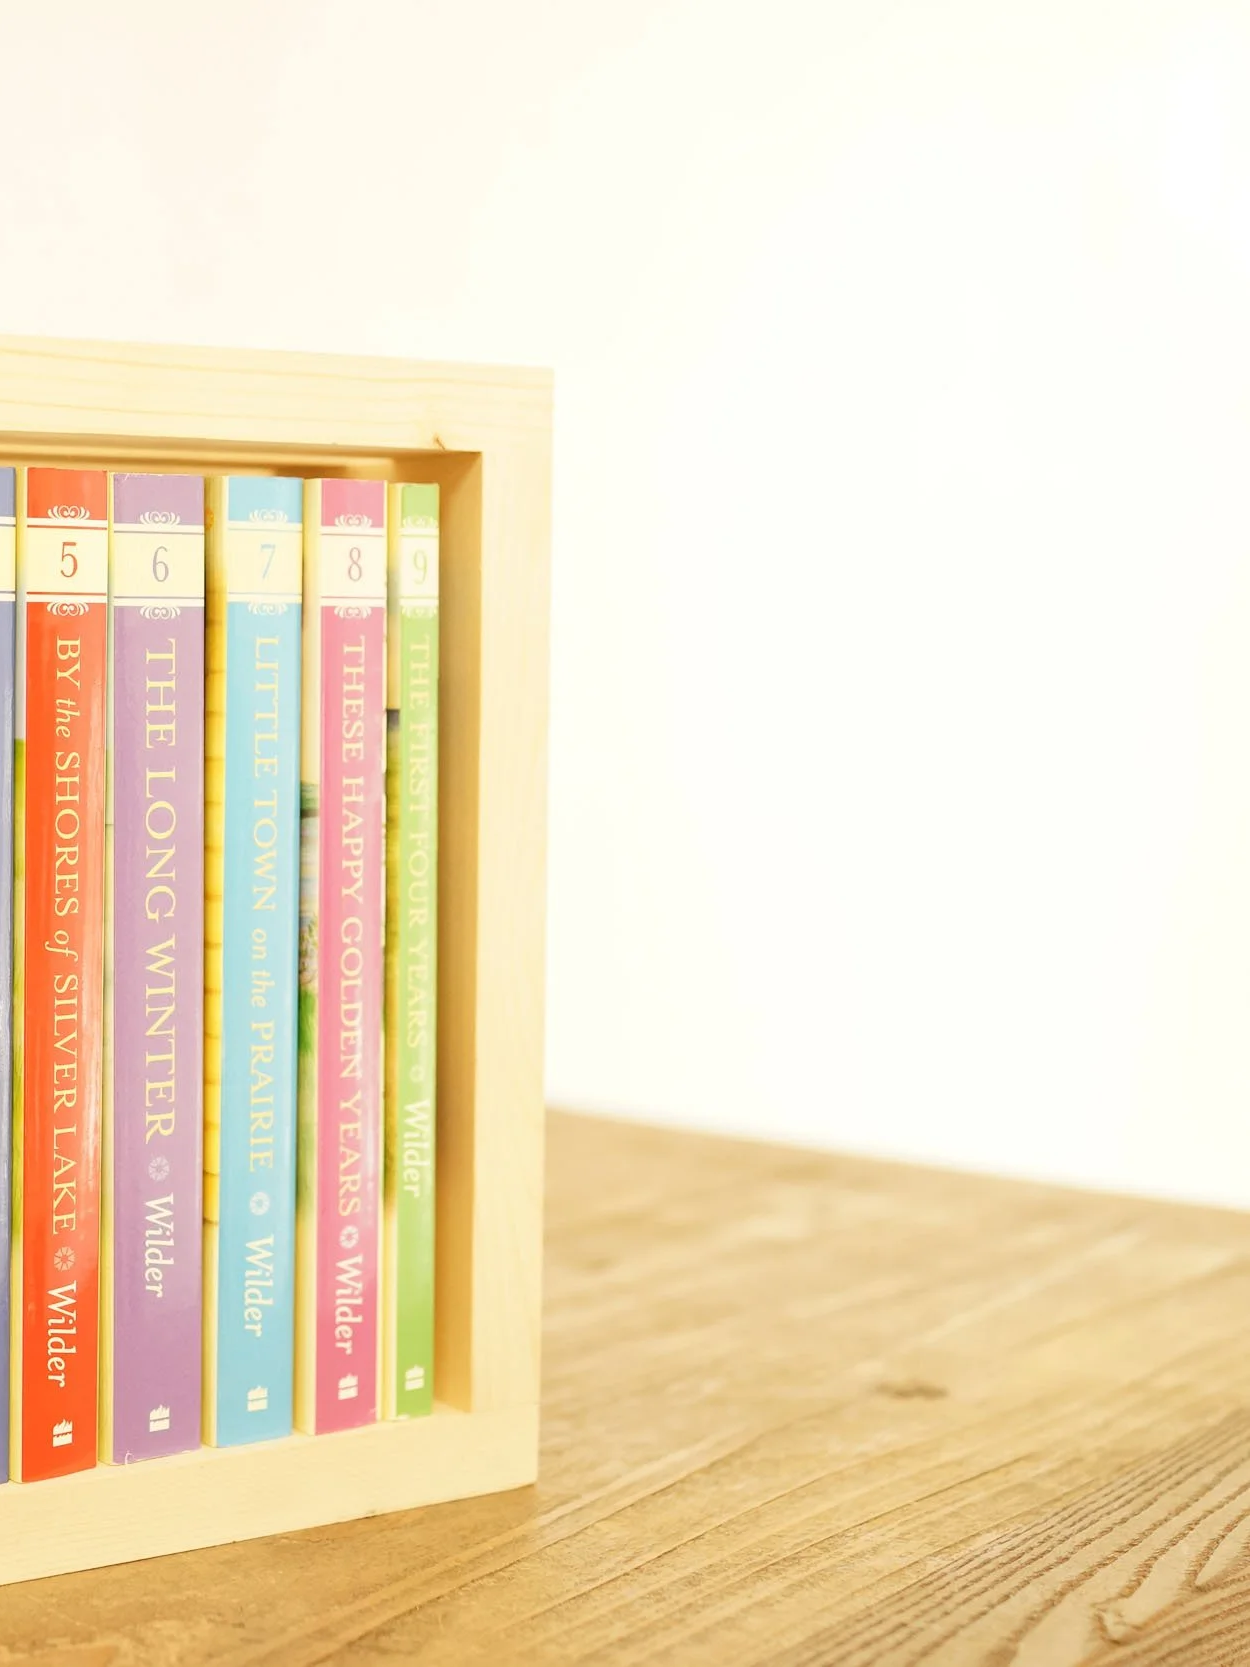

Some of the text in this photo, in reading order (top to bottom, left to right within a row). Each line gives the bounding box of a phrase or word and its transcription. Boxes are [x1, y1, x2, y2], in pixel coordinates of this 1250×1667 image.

[60, 541, 78, 578] 5
[151, 546, 169, 582] 6
[259, 544, 276, 580] 7
[347, 547, 362, 582] 8
[413, 549, 427, 584] 9
[45, 636, 81, 1387] BY the SHORES of SILVER LAKE Wilder
[144, 638, 177, 1298] THE LONG WINTER Wilder
[243, 636, 279, 1336] LITTLE TOWN on the PRAIRIE Wilder
[334, 636, 365, 1355] THESE HAPPY GOLDEN YEARS Wilder
[401, 636, 430, 1198] THE FIRST FOUR YEARS Wilder
